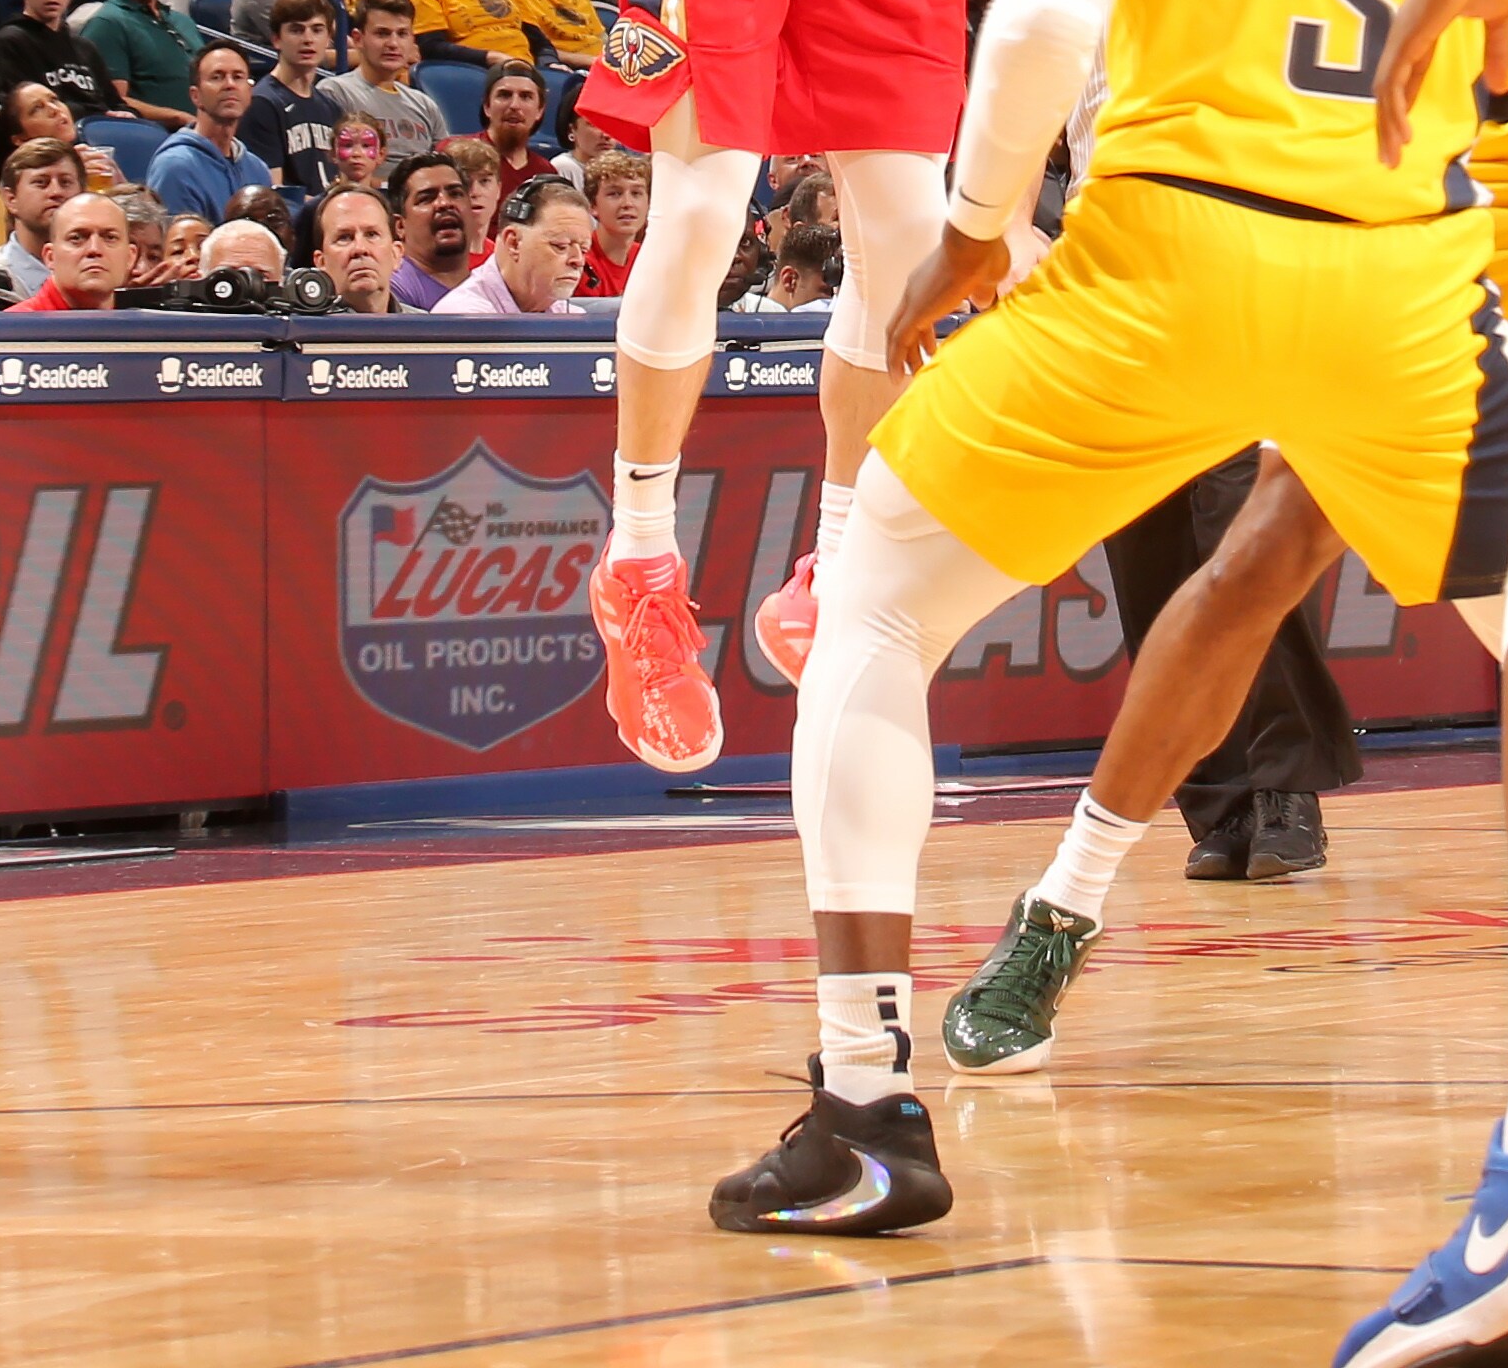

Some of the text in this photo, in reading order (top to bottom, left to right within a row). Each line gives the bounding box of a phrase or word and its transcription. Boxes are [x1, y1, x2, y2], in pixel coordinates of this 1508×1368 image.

[28, 361, 109, 390] SeatGeek
[186, 361, 263, 389] SeatGeek
[334, 363, 409, 390] SeatGeek
[478, 362, 550, 389] SeatGeek
[750, 361, 815, 387] SeatGeek
[371, 543, 593, 620] LUCAS
[358, 633, 598, 673] OIL PRODUCTS
[450, 684, 516, 716] INC.
